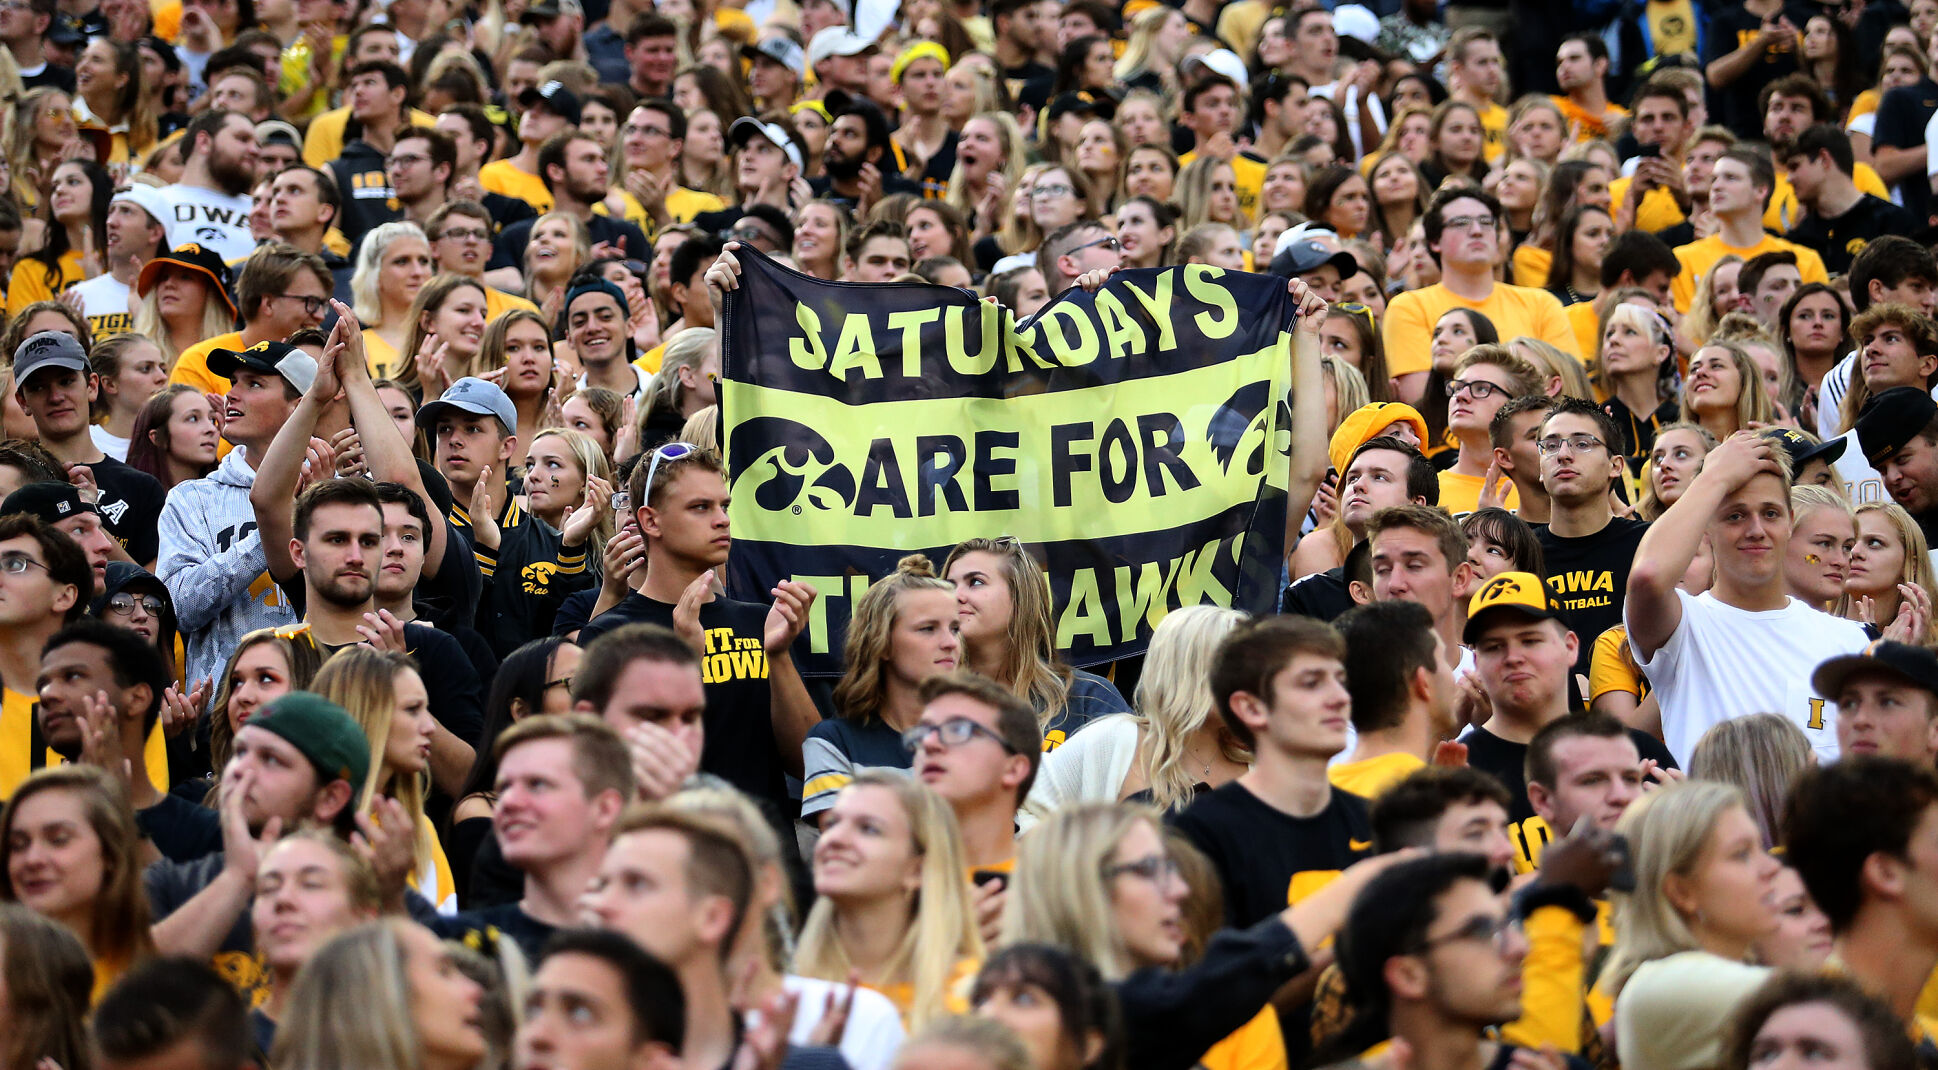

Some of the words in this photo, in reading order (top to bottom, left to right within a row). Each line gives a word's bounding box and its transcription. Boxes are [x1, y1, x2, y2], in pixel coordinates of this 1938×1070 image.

[789, 264, 1239, 382] SATURDAYS
[24, 337, 61, 357] IOWA
[853, 432, 1020, 518] ARE
[1051, 412, 1201, 507] FOR
[733, 637, 763, 651] FOR
[1807, 697, 1825, 731] I
